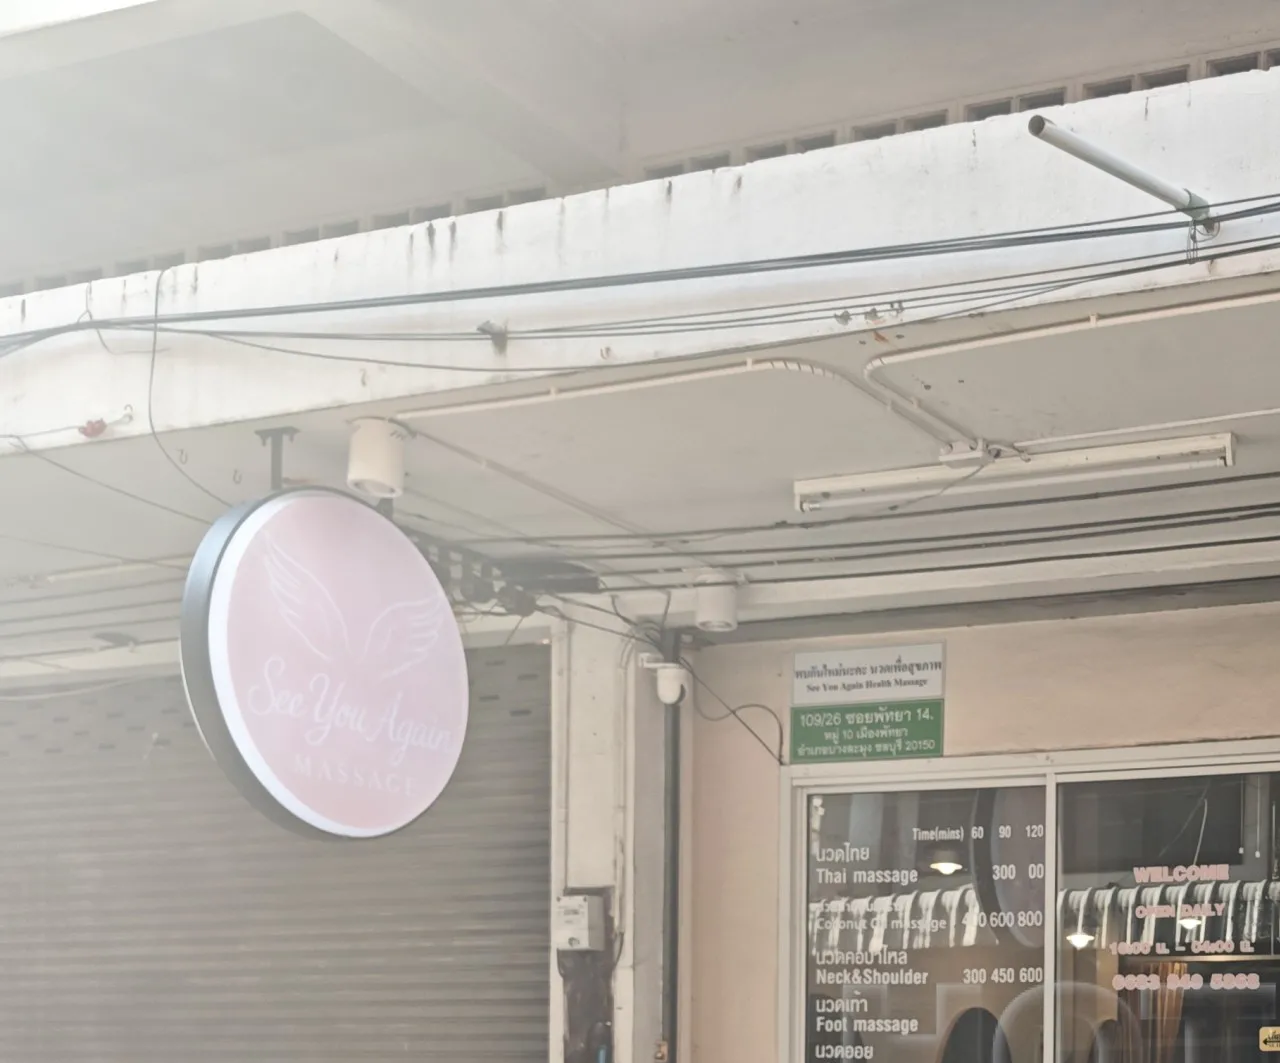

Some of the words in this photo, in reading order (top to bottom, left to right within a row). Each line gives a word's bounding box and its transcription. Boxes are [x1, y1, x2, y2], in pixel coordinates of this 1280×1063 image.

[822, 683, 838, 691] You
[841, 681, 863, 691] Again
[866, 680, 892, 688] Health
[894, 678, 928, 687] Massage
[248, 656, 306, 715] See
[304, 673, 366, 746] You
[366, 690, 454, 767] Again
[800, 712, 841, 727] 109/26
[846, 707, 911, 725] ซอยพัทยา
[843, 729, 853, 739] 10
[906, 740, 935, 751] 20150
[293, 754, 418, 795] MASSAGE
[971, 827, 983, 839] 60
[999, 826, 1011, 838] 90
[1026, 825, 1043, 837] 120
[815, 842, 870, 862] นวดไทย
[816, 869, 847, 884] Thai
[853, 867, 918, 885] massage
[992, 865, 1016, 879] 300
[1133, 864, 1229, 883] WELCOME
[990, 912, 1014, 927] 600
[1017, 911, 1042, 926] 800
[1135, 904, 1175, 919] OPEN
[1180, 902, 1225, 917] DAILY
[816, 969, 928, 985] Neck&Shoulder
[963, 969, 986, 984] 300
[991, 968, 1015, 983] 450
[1019, 967, 1043, 982] 600
[815, 991, 868, 1013] นวดเท้า
[816, 1017, 848, 1032] Foot
[853, 1018, 918, 1035] massage
